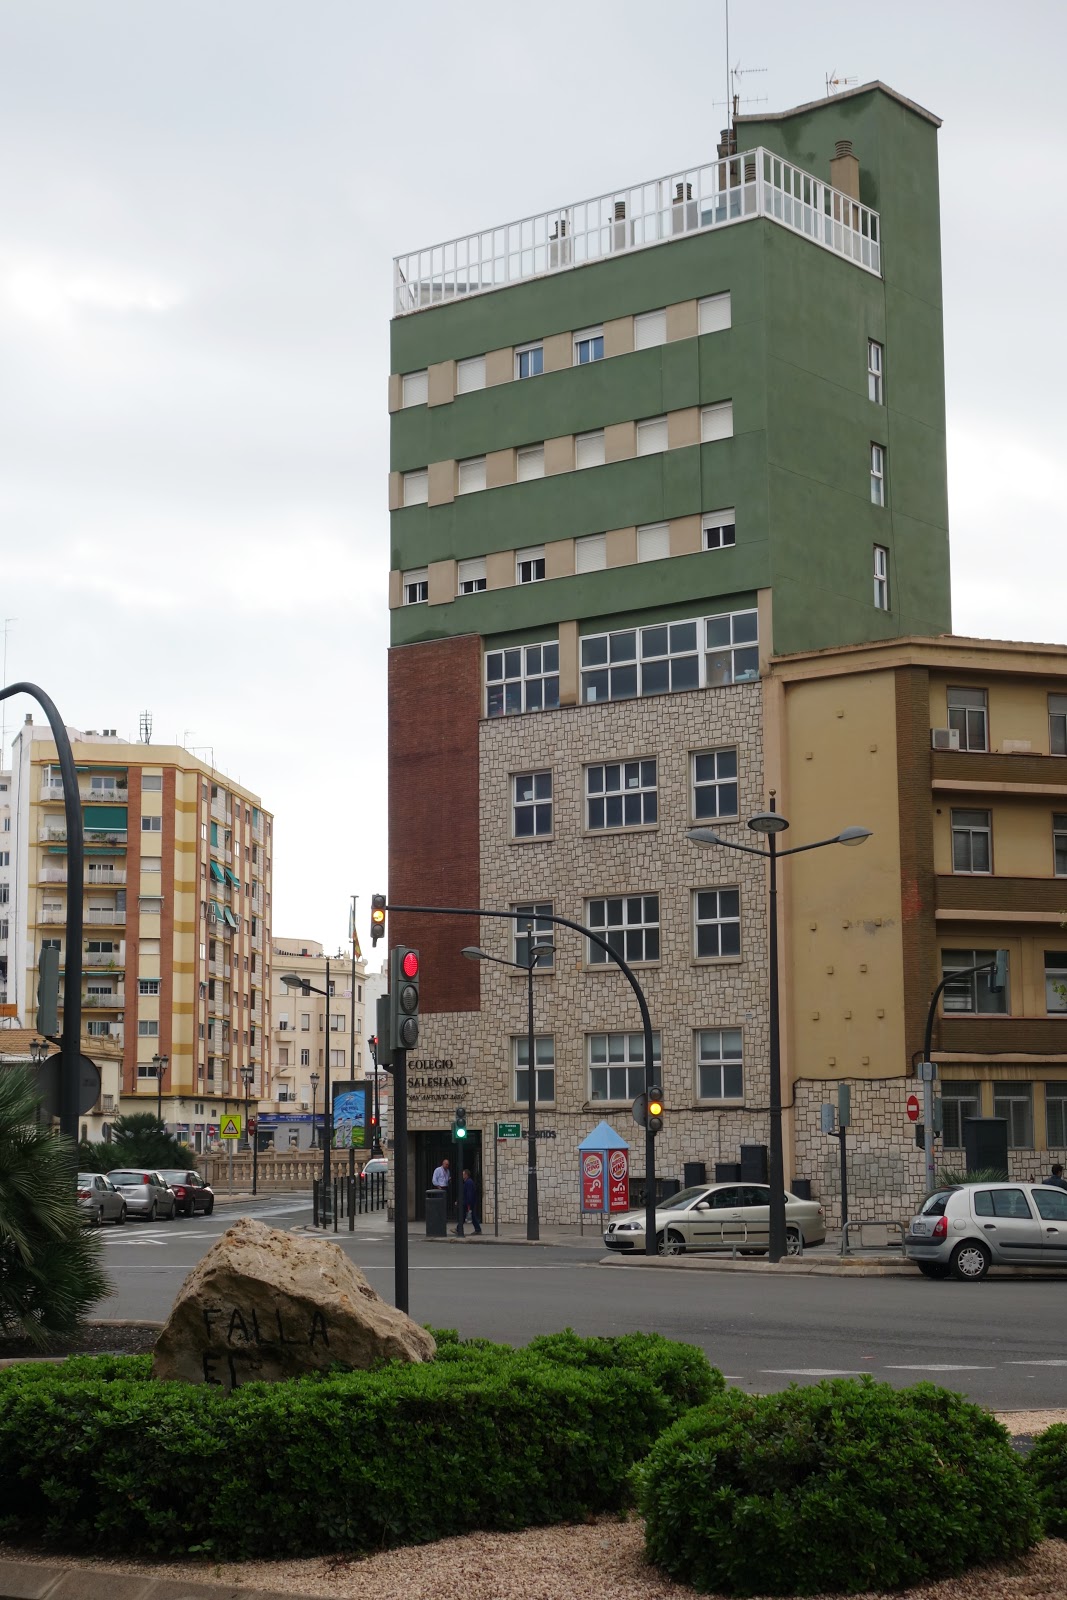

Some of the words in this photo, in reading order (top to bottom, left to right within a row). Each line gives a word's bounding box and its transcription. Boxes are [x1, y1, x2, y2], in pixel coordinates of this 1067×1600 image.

[408, 1060, 453, 1070] COLEGIO
[408, 1076, 467, 1088] SALESIANO
[587, 1163, 600, 1173] KING
[612, 1161, 625, 1173] KING
[203, 1308, 330, 1348] FALLA
